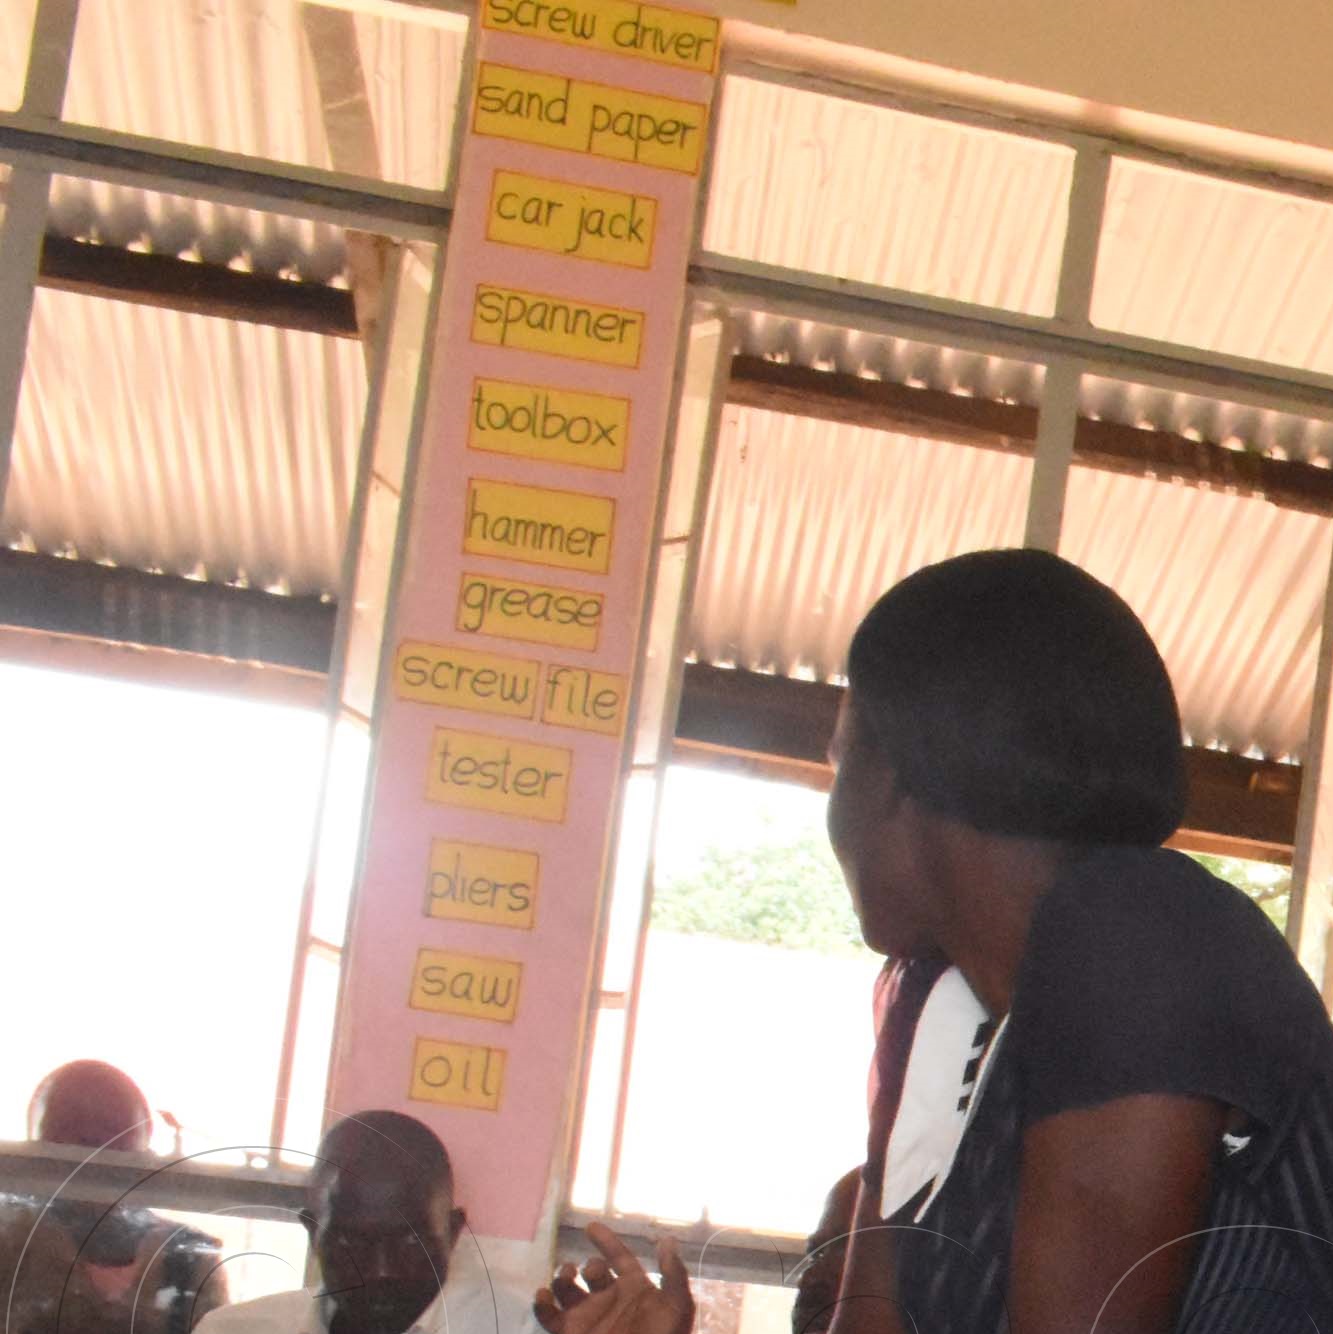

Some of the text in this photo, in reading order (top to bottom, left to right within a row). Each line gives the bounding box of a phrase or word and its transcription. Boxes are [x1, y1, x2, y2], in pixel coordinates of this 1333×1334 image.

[492, 0, 713, 61] screw driver
[478, 79, 698, 161] sand paper
[496, 188, 646, 254] car jack
[477, 288, 639, 346] spanner
[473, 390, 618, 449] toolbox
[469, 487, 608, 558] hammer
[462, 579, 601, 632] grease
[401, 652, 619, 721] screw file
[438, 739, 563, 799] tester
[428, 853, 531, 917] pliers
[420, 962, 514, 1009] saw
[419, 1046, 495, 1099] oil
